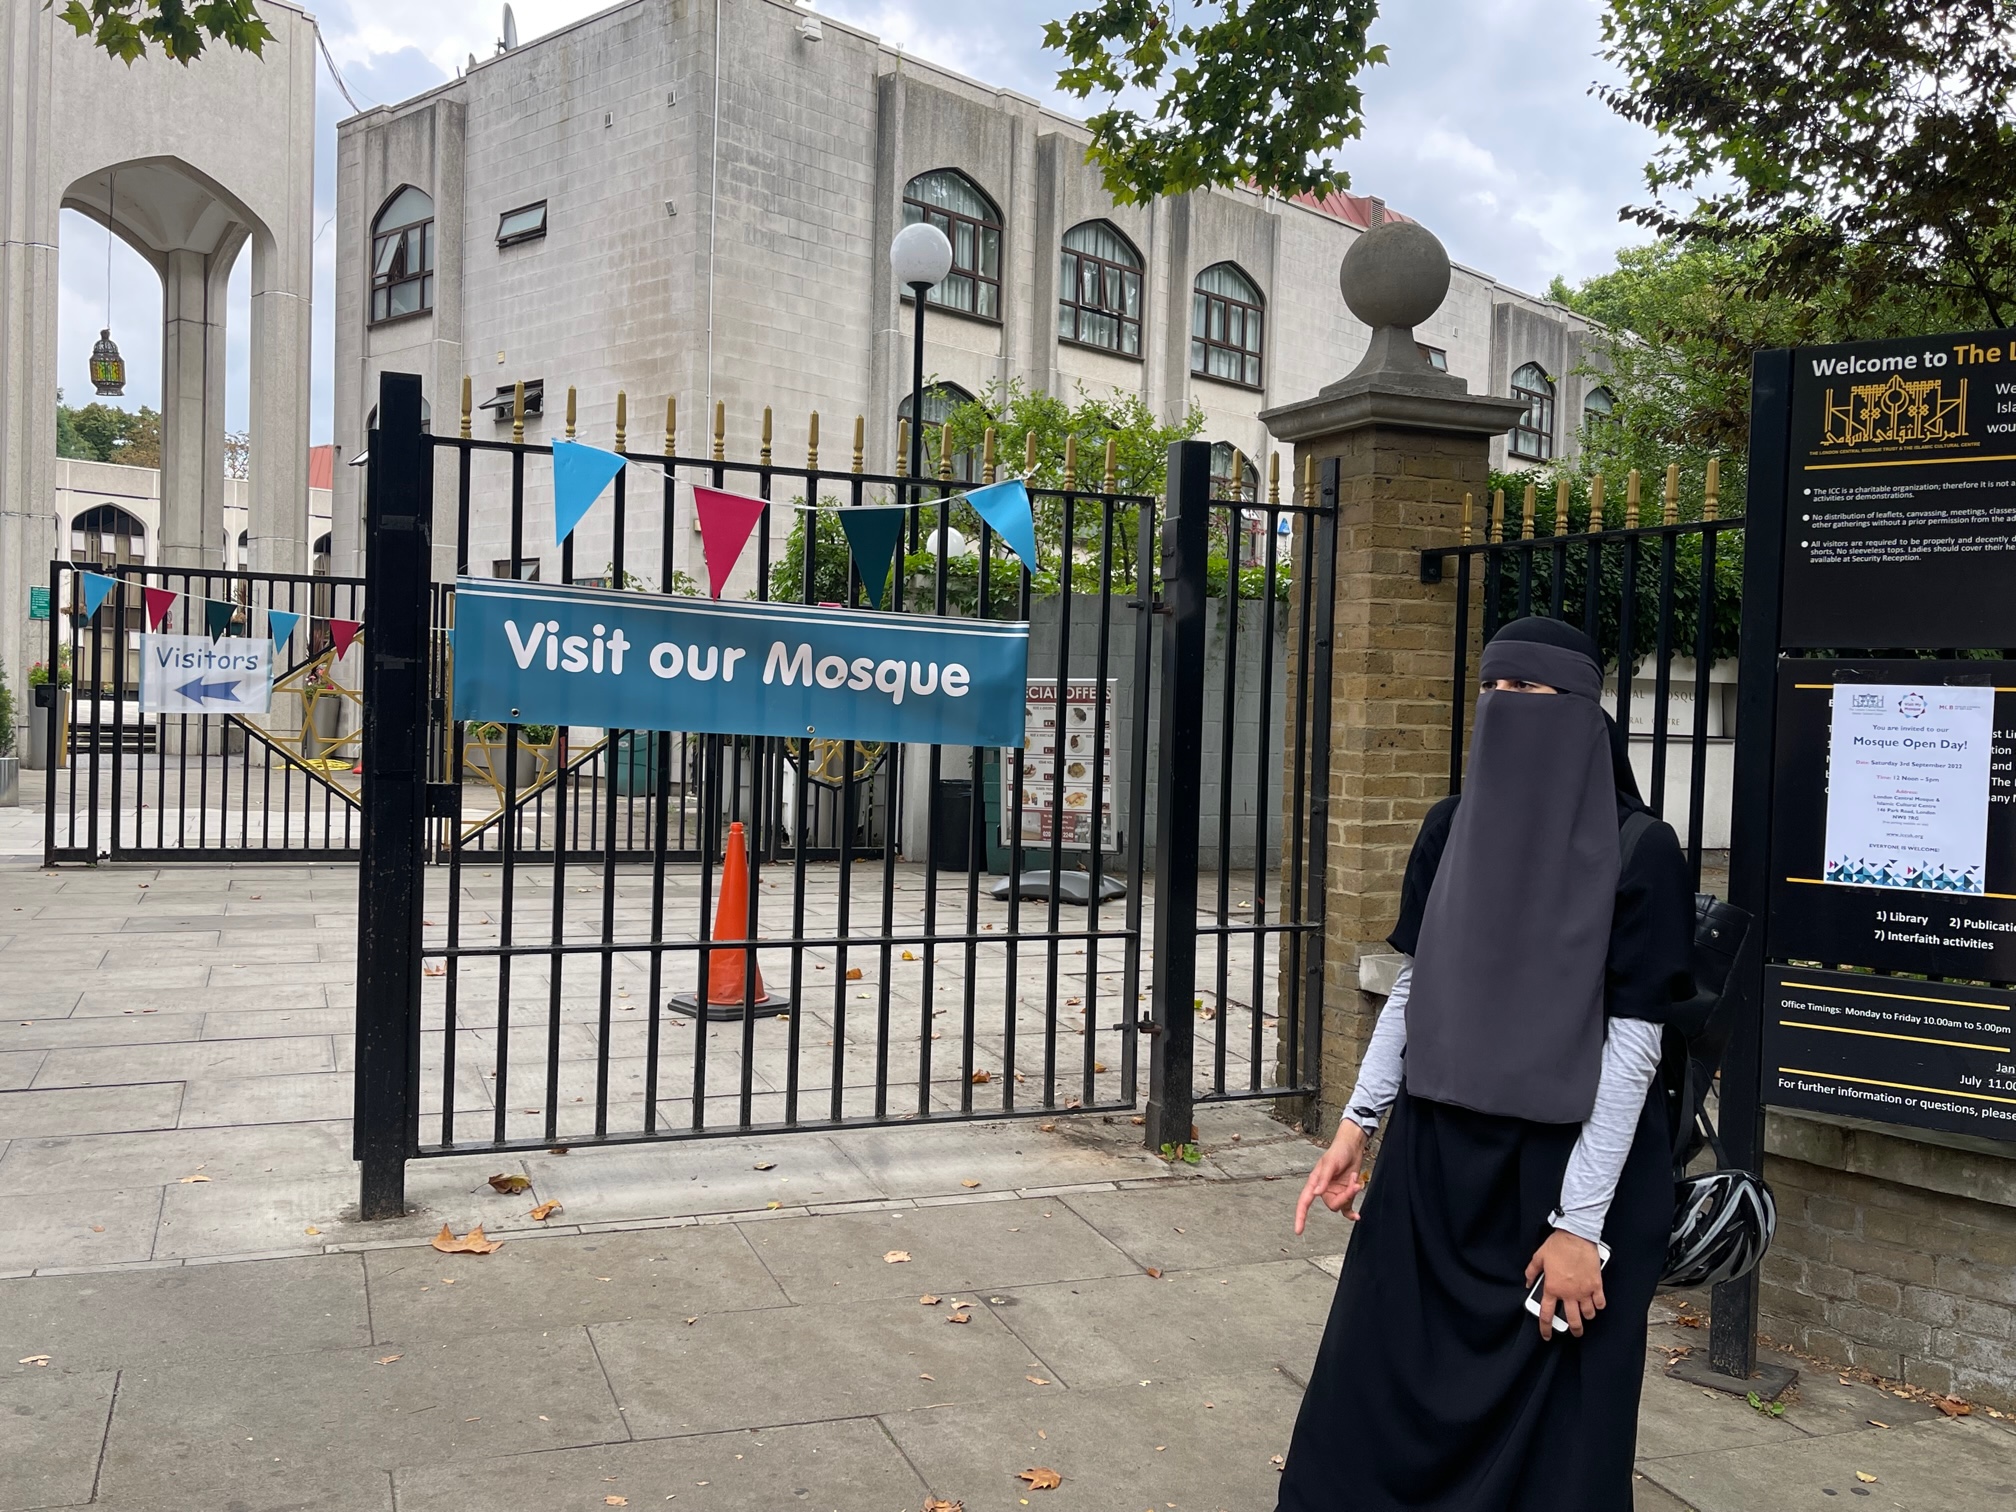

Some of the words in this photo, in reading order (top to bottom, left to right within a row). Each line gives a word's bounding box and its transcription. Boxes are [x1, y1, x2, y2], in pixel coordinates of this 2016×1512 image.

[1812, 355, 1917, 376] Welcome
[1923, 351, 1947, 368] to
[1953, 344, 2001, 365] The
[1855, 485, 1891, 493] charitable
[1892, 483, 1941, 493] organization;
[1942, 481, 1979, 490] therefore
[1812, 494, 1845, 502] activities
[1855, 492, 1915, 500] demonstrations.
[1824, 512, 1865, 520] distribution
[1875, 511, 1905, 519] leaflets,
[1906, 510, 1948, 518] canvassing,
[1950, 508, 1987, 516] meetings,
[1812, 521, 1831, 529] other
[1832, 520, 1870, 529] gatherings
[1908, 518, 1927, 526] prior
[1928, 517, 1969, 526] permission
[1865, 539, 1897, 547] required
[1923, 537, 1955, 545] properly
[1958, 536, 1972, 544] and
[1975, 535, 2009, 544] decently
[1852, 555, 1881, 563] Security
[1882, 554, 1921, 562] Reception.
[156, 646, 258, 671] Visitors
[504, 619, 631, 675] Visit
[649, 641, 746, 682] our
[763, 641, 971, 705] Mosque
[1066, 686, 1111, 700] OFFES
[2005, 730, 2016, 739] Li
[1854, 736, 1899, 748] Mosque
[1903, 738, 1936, 750] Open
[1940, 740, 1968, 752] Day!
[1992, 762, 2012, 770] and
[1991, 777, 2011, 786] The
[1989, 794, 2010, 805] any
[1875, 911, 1887, 922] 1)
[1890, 912, 1929, 926] Library
[1949, 917, 1961, 929] 2)
[1963, 918, 2016, 932] Publicati
[1874, 930, 1885, 942] 7)
[1887, 931, 1940, 945] Interfaith
[1943, 938, 1994, 950] activities
[1781, 999, 1806, 1010] Office
[1808, 1002, 1842, 1015] Timings:
[1845, 1007, 1880, 1020] Monday
[1882, 1011, 1892, 1020] to
[1894, 1012, 1921, 1024] Friday
[1923, 1016, 1962, 1028] 10.00am
[1964, 1021, 1974, 1030] to
[1976, 1022, 2011, 1034] 5.00pm
[1996, 1062, 2015, 1074] Jan
[1960, 1075, 1982, 1088] July
[1778, 1078, 1795, 1088] For
[1797, 1079, 1835, 1095] further
[1838, 1085, 1902, 1104] information
[1905, 1096, 1917, 1106] or
[1920, 1098, 1978, 1117] questions,
[1981, 1107, 2016, 1120] please
